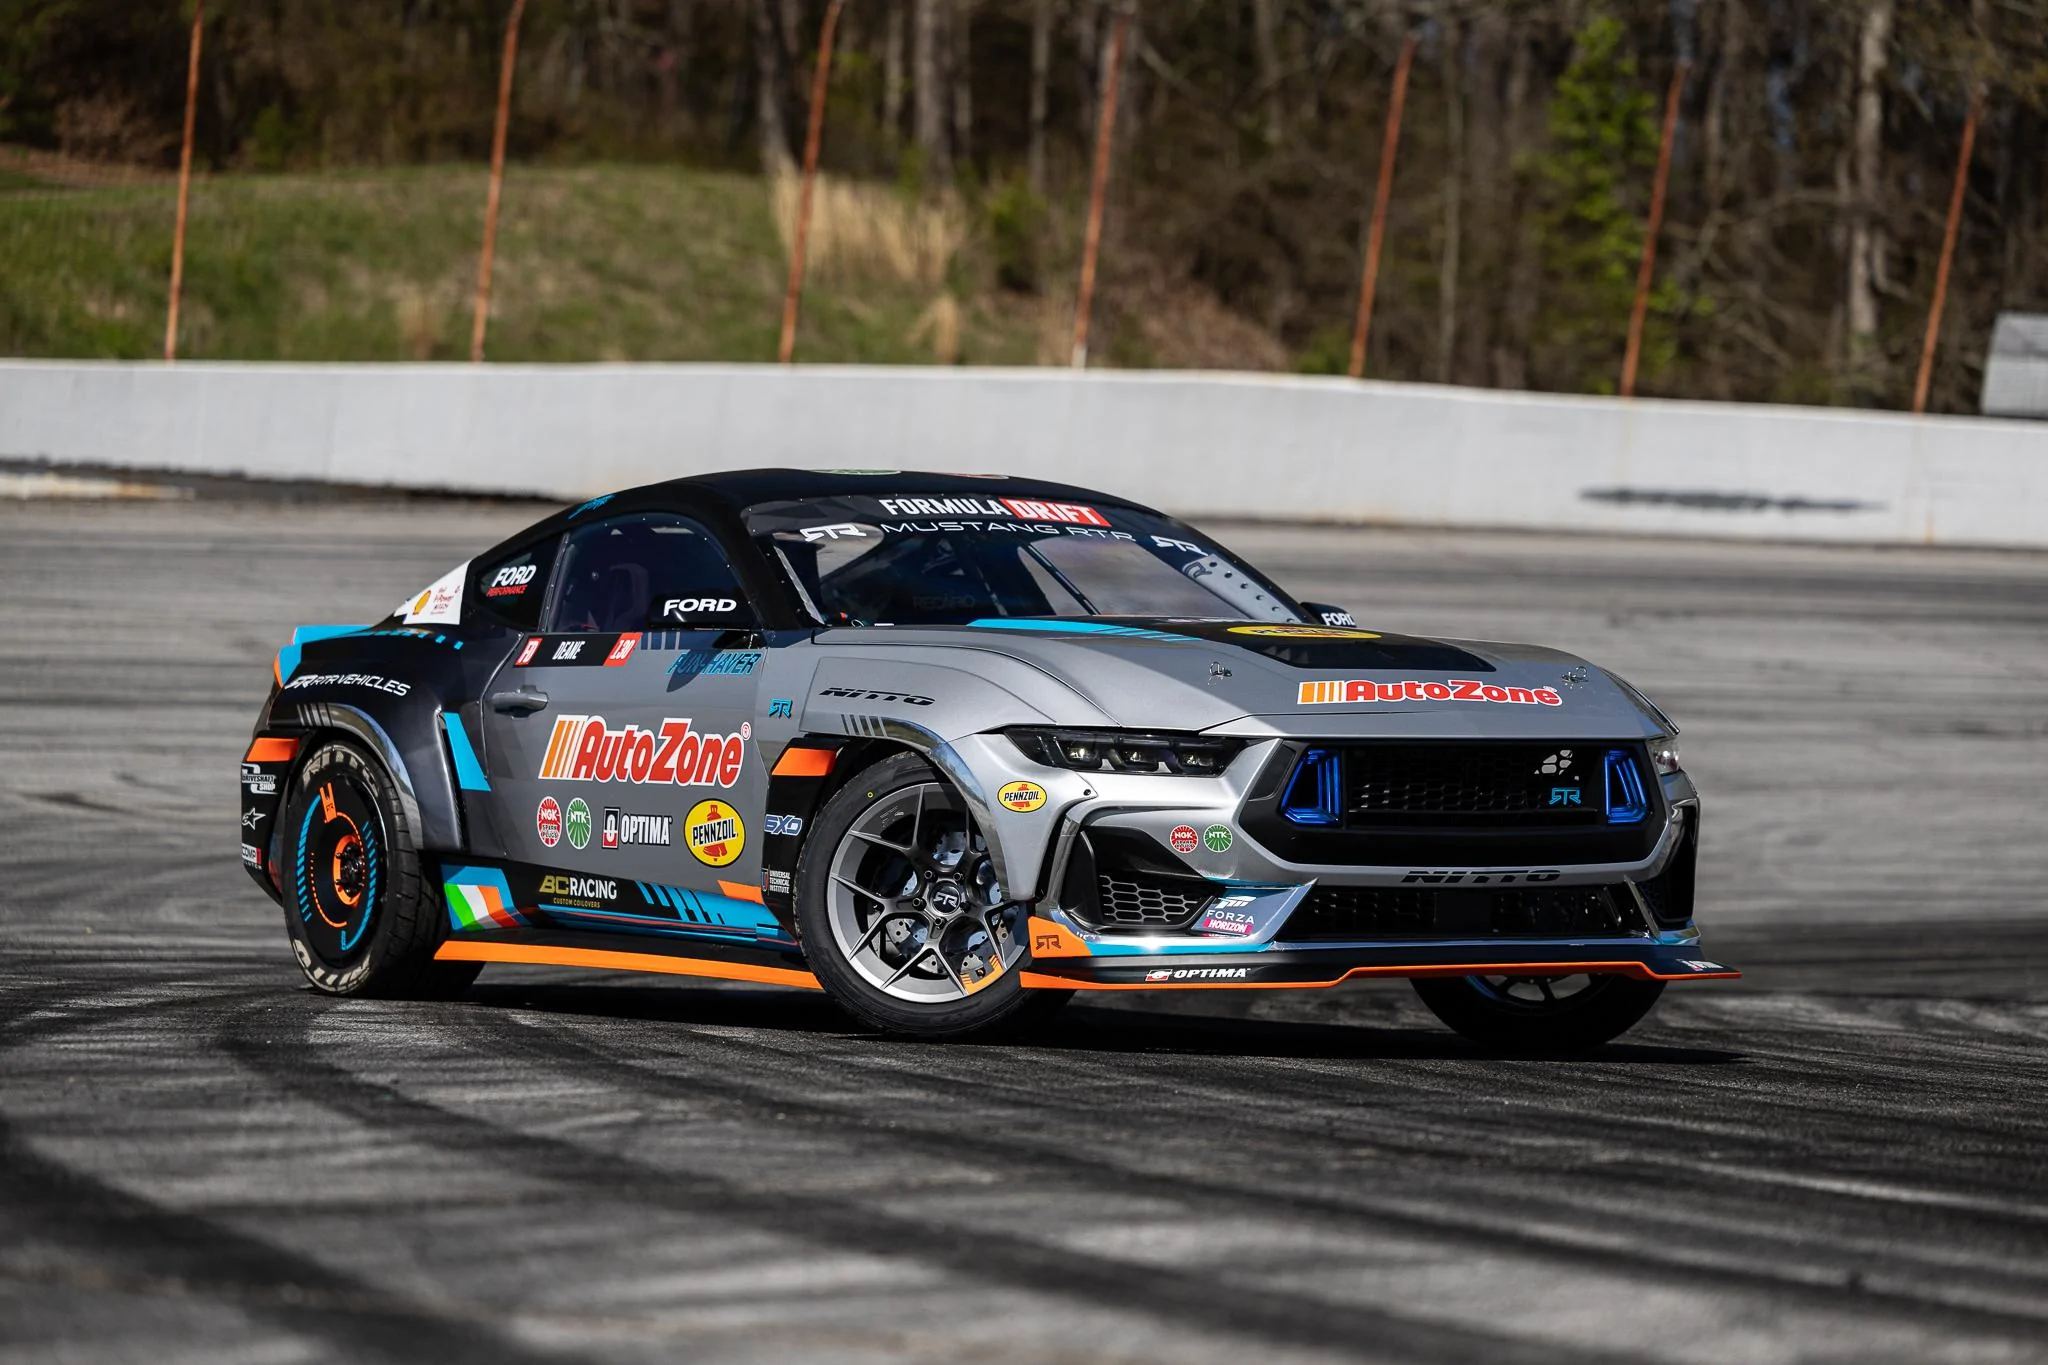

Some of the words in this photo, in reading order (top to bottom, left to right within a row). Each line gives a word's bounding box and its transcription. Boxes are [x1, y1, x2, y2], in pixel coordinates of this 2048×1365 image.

[878, 498, 1013, 517] FORMULA
[1016, 500, 1100, 525] DRIFT
[880, 521, 1059, 536] MUSTANG
[1065, 526, 1136, 543] RTR
[491, 564, 537, 588] FORD
[486, 584, 528, 597] PERFORMANCE
[663, 598, 737, 617] FORD
[552, 640, 586, 660] DEANE
[609, 639, 636, 660] 130
[337, 673, 411, 697] VEHICLES
[1345, 680, 1562, 706] AutoZone
[818, 687, 936, 706] NITTO
[572, 717, 744, 787] AutoZone
[1003, 790, 1041, 802] PENNZOIL
[541, 809, 558, 821] NGK
[570, 810, 587, 823] NTK
[620, 814, 671, 845] OPTIMA
[691, 818, 737, 847] PENNZOIL
[1208, 831, 1227, 839] NTK
[769, 870, 791, 880] UNIVERSAL
[769, 877, 790, 887] TECHNICAL
[1400, 870, 1561, 884] NITTO
[569, 877, 617, 900] RACING
[769, 884, 790, 894] INSTITUTE
[553, 897, 573, 906] CUSTOM
[573, 899, 601, 908] COILOVERS
[1206, 909, 1255, 925] FORZA
[1207, 918, 1249, 933] HORIZON
[1172, 967, 1248, 979] OPTIMA
